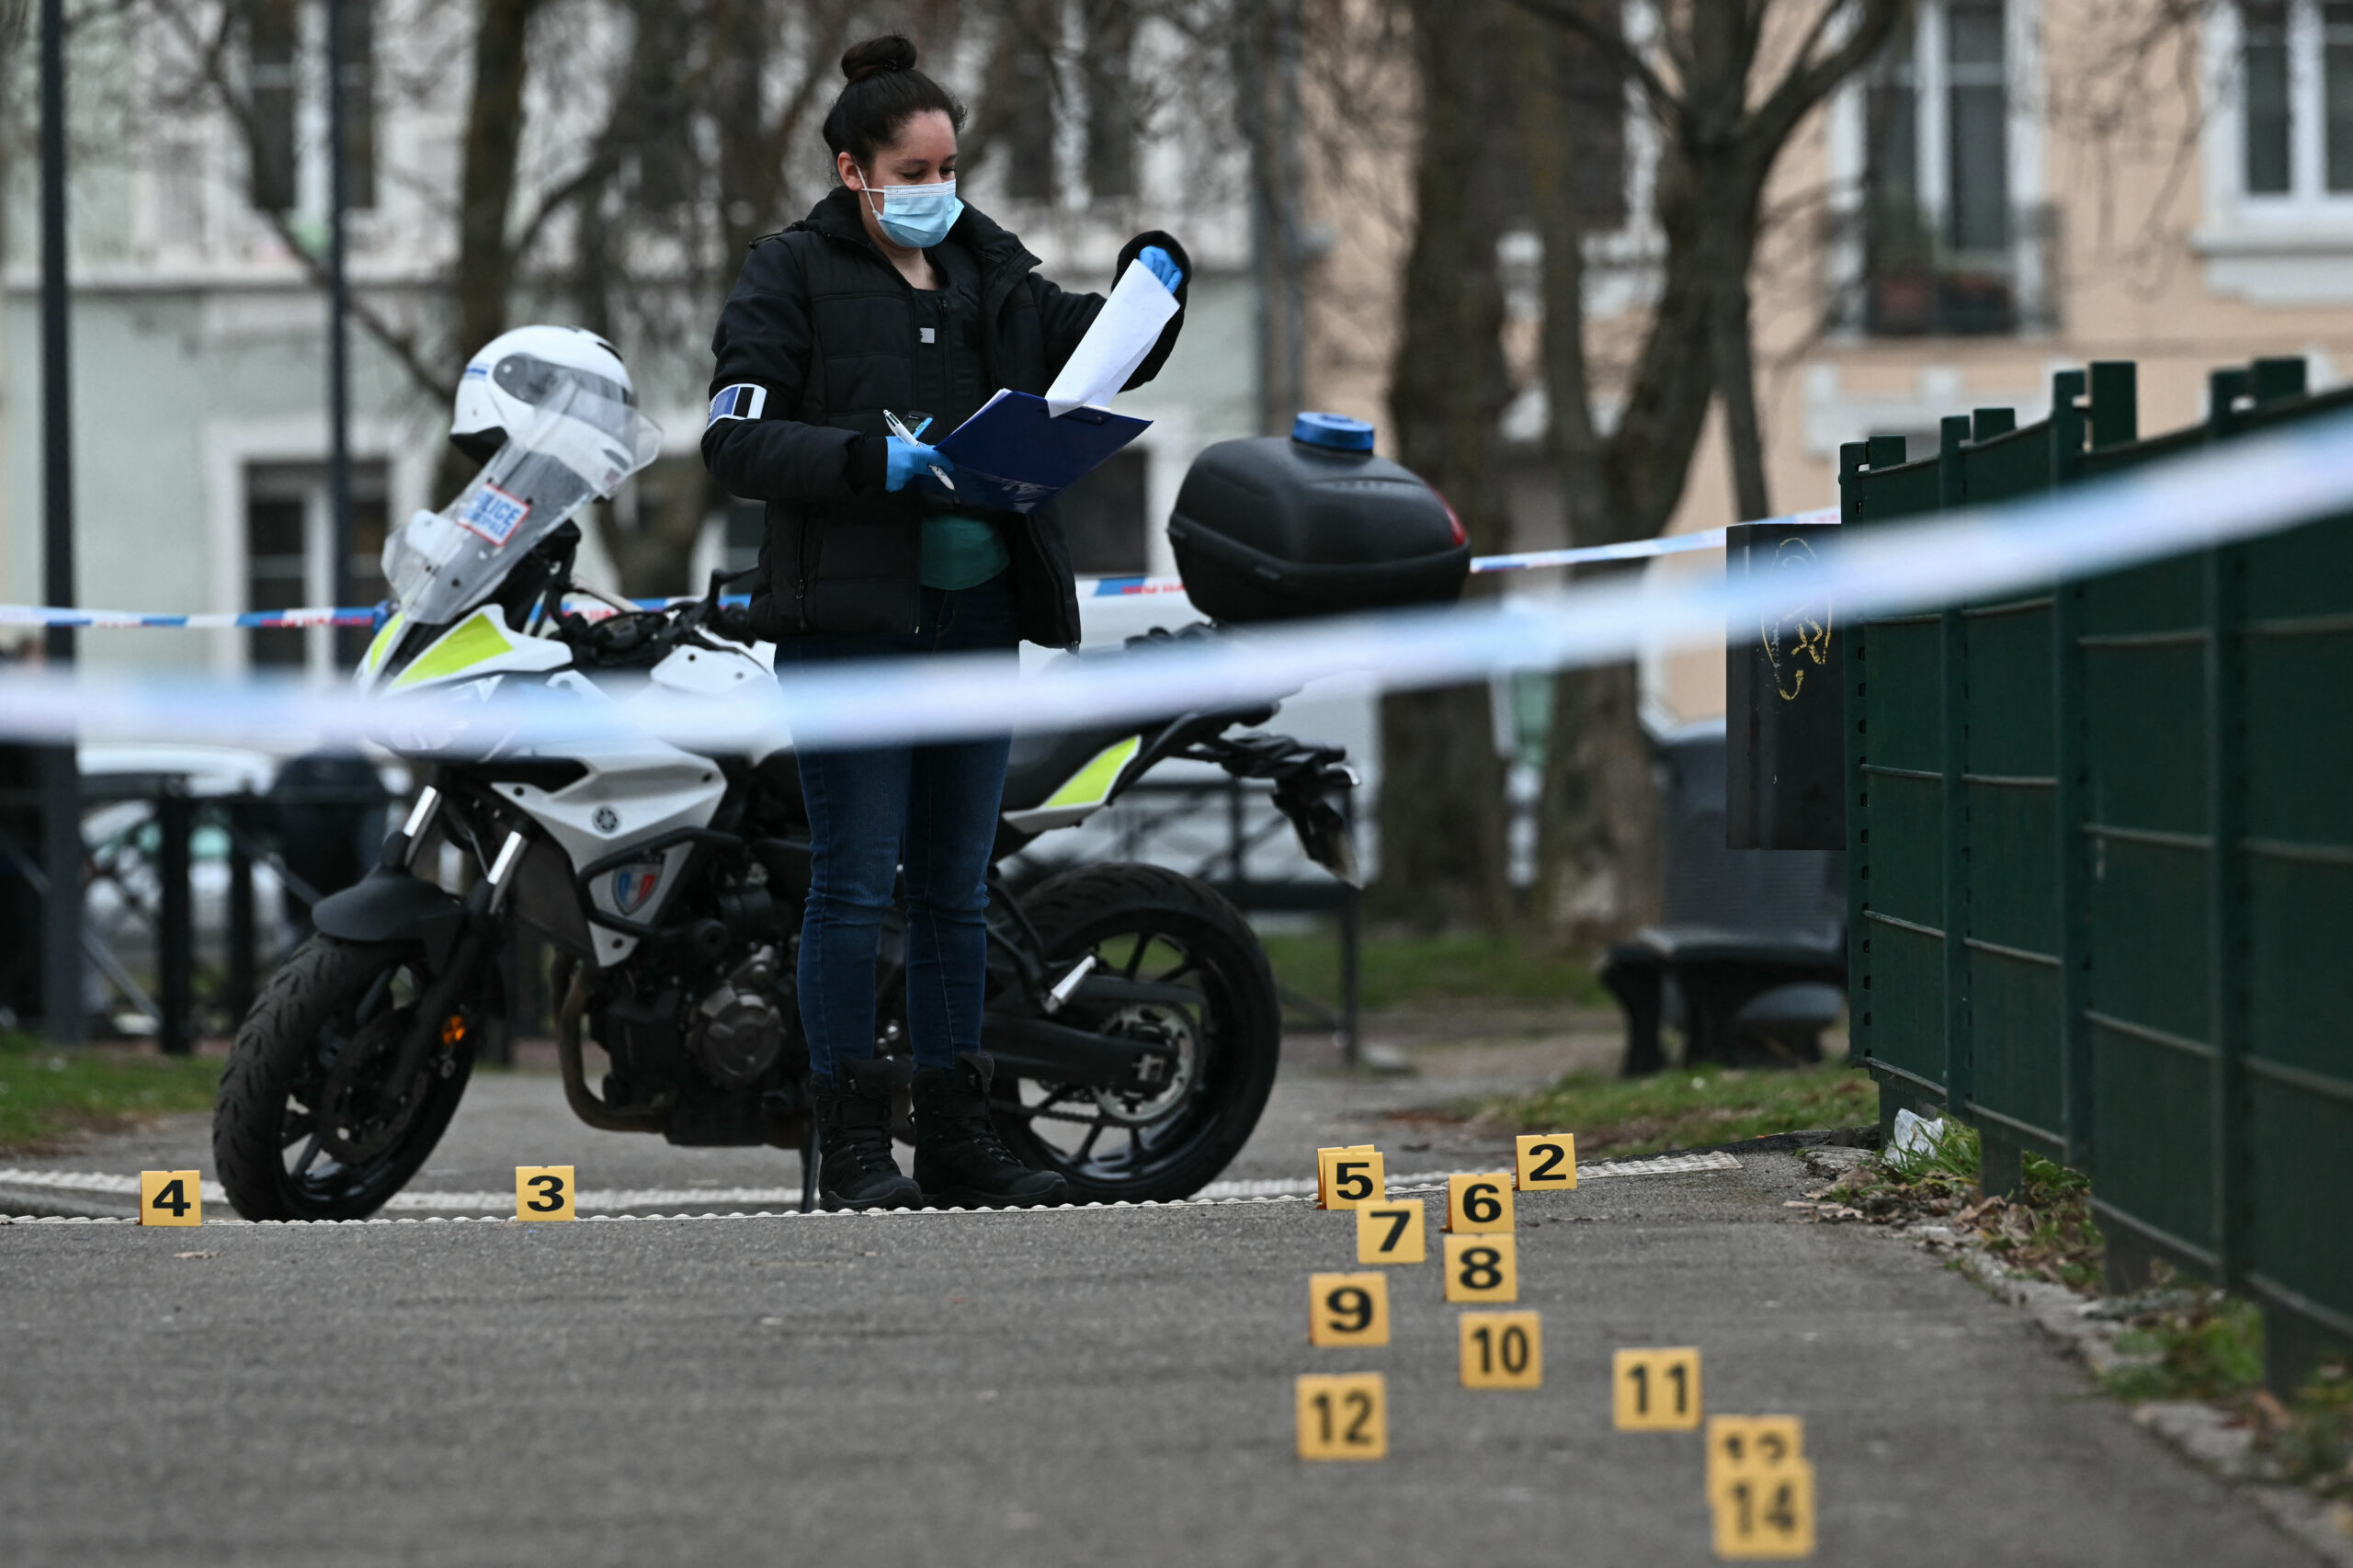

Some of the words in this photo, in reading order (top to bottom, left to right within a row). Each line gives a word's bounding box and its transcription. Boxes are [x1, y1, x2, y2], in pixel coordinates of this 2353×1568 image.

[472, 490, 521, 528] LICE
[1336, 1162, 1374, 1201] 5
[1529, 1143, 1567, 1182] 2
[152, 1179, 191, 1218] 4
[527, 1175, 565, 1212] 3
[1462, 1183, 1502, 1223] 6
[1370, 1210, 1411, 1253] 7
[1459, 1246, 1503, 1290] 8
[1326, 1287, 1374, 1334] 9
[1471, 1324, 1529, 1376] 10
[1627, 1362, 1688, 1416] 11
[1310, 1390, 1374, 1447] 12
[1730, 1480, 1797, 1538] 14
